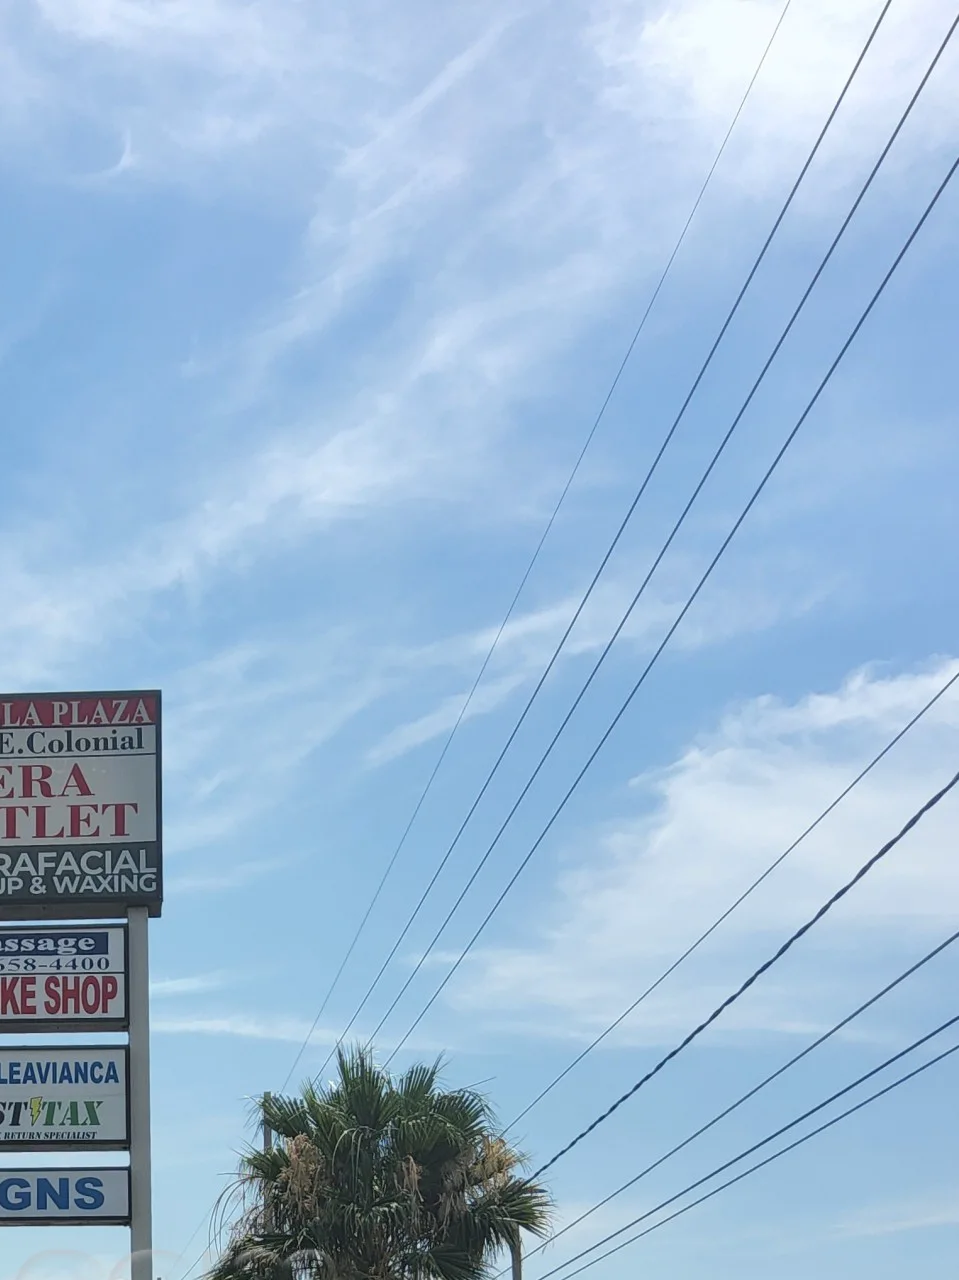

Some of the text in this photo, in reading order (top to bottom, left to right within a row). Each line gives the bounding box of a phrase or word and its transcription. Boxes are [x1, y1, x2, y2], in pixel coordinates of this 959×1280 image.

[52, 698, 153, 725] PLAZA
[29, 876, 46, 894] &
[52, 874, 157, 893] WAXING
[44, 976, 118, 1015] SHOP
[41, 1101, 103, 1126] TAX
[4, 1132, 41, 1140] RETURN
[44, 1131, 97, 1140] SPECIALIST
